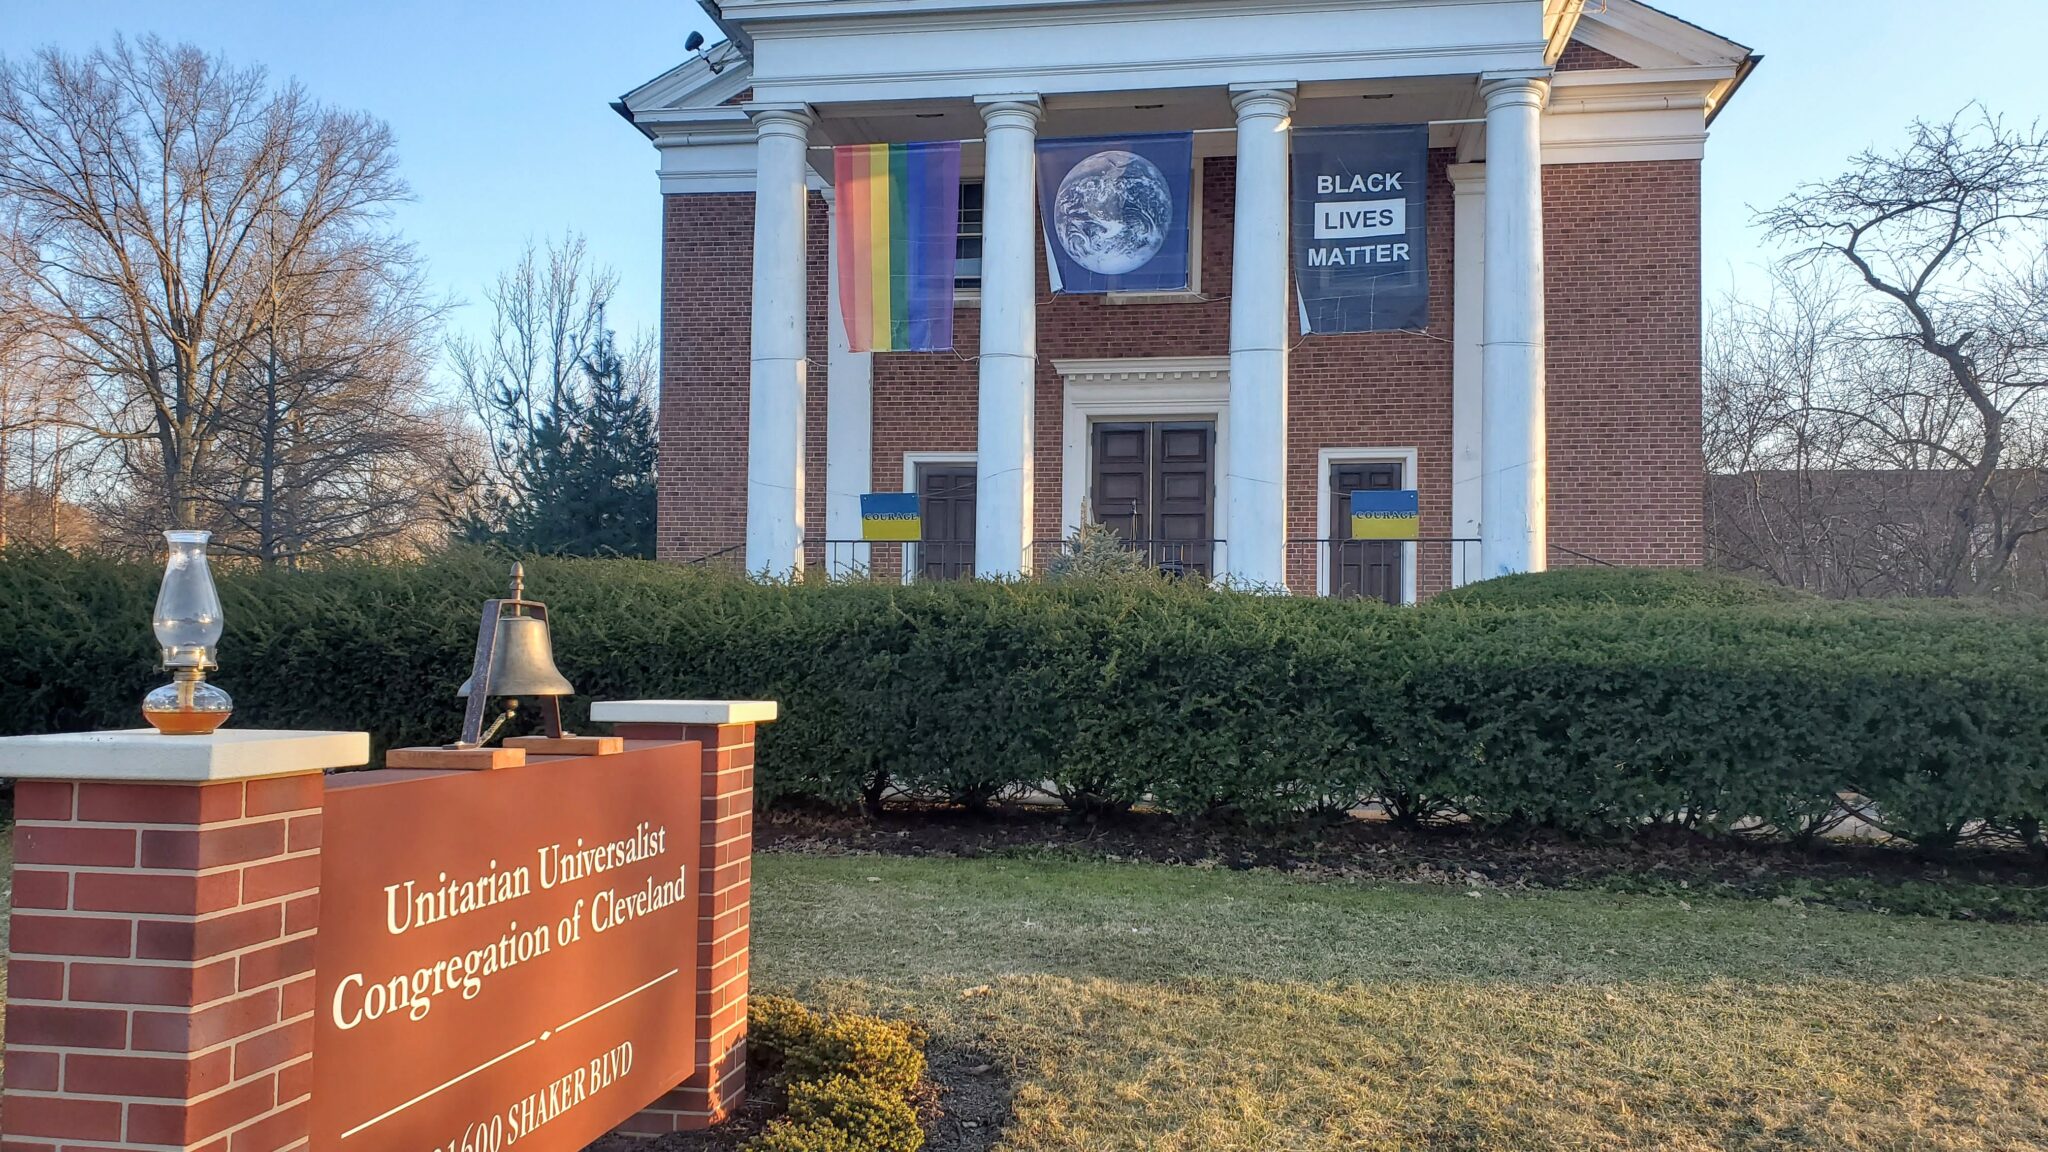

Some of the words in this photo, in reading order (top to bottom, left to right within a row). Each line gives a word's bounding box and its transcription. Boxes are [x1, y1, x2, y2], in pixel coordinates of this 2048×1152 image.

[1317, 172, 1403, 194] BLACK
[1324, 208, 1394, 230] LIVES
[1307, 243, 1411, 267] MATTER
[864, 511, 918, 521] COURAGE
[1355, 510, 1417, 520] COURAGE
[384, 859, 531, 935] Unitarian
[537, 821, 666, 889] Universalist
[332, 920, 551, 1030] Congregation
[557, 899, 584, 947] of
[591, 865, 686, 933] Cleveland
[433, 1114, 502, 1152] 600
[506, 1066, 586, 1146] SHAKER
[589, 1040, 634, 1097] BLVD
